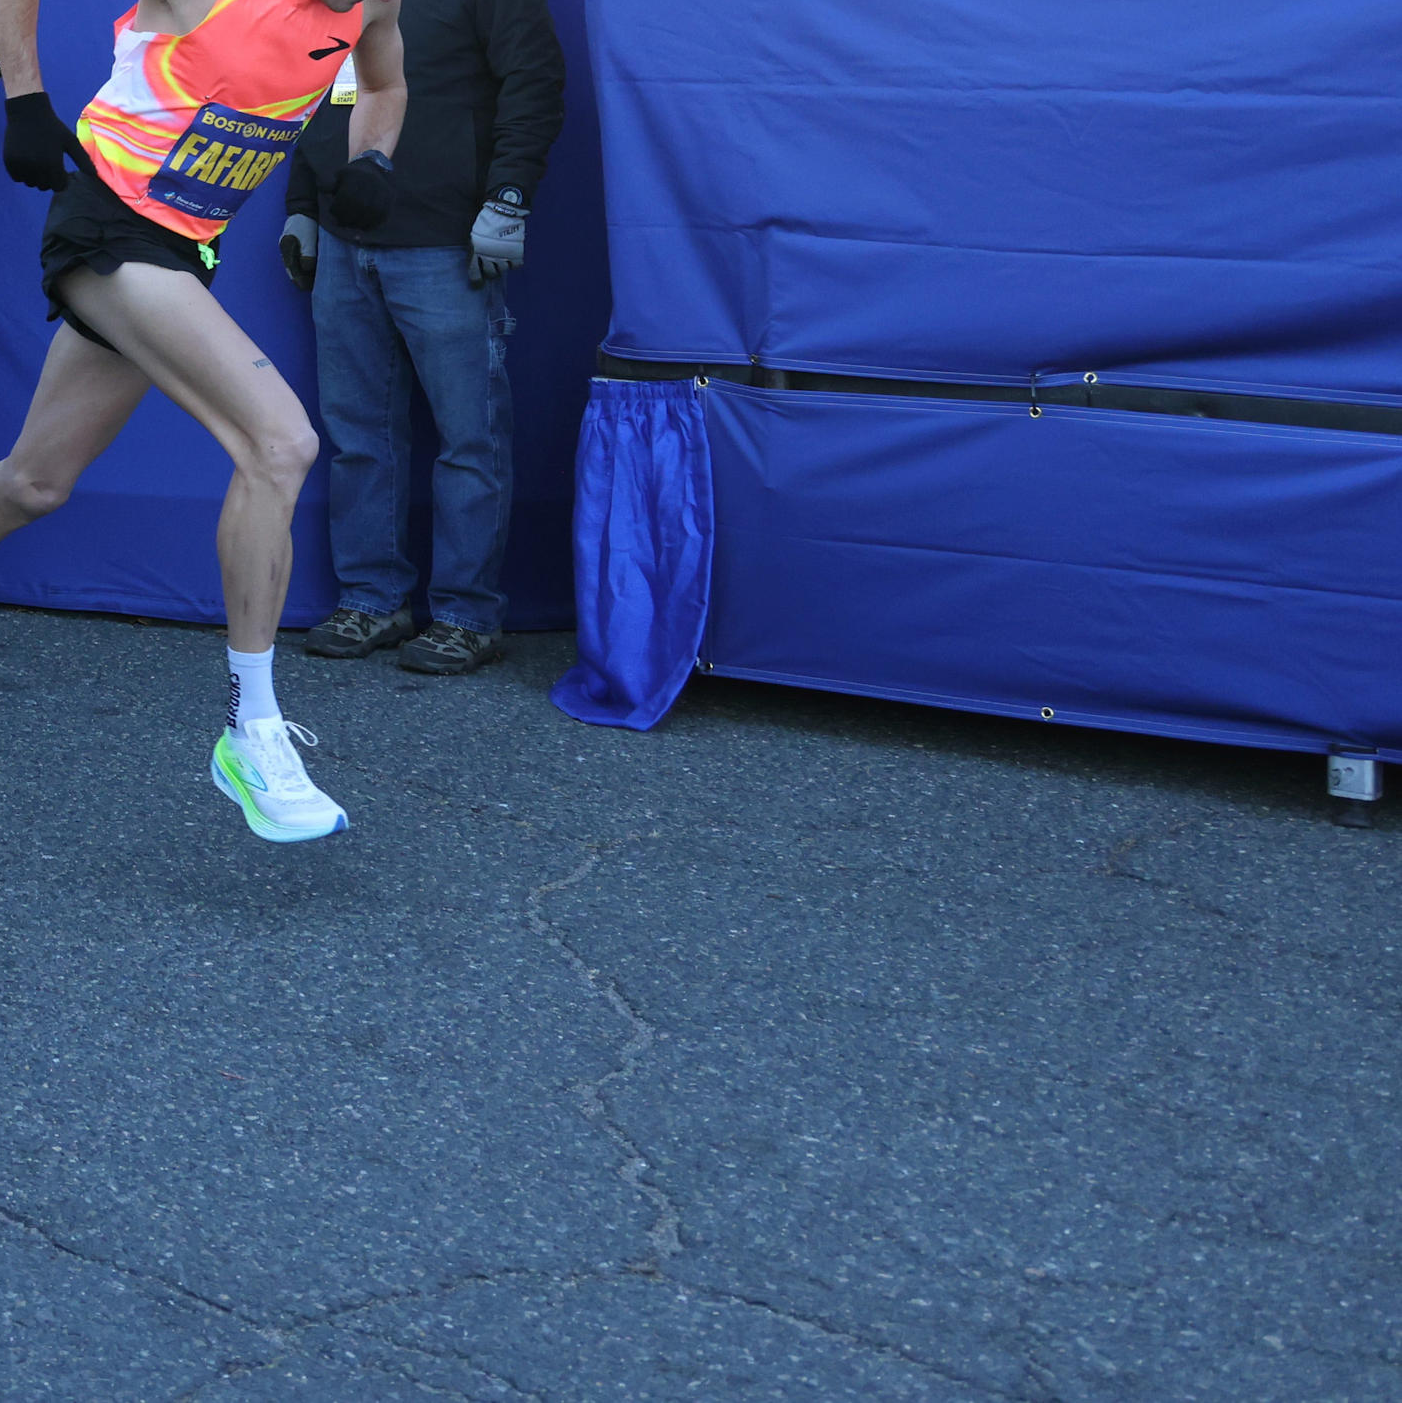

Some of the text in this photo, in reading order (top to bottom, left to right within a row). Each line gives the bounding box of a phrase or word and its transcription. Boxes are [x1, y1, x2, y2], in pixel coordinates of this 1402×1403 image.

[201, 110, 299, 142] BOSTON HALF
[227, 672, 242, 730] BROOKS
